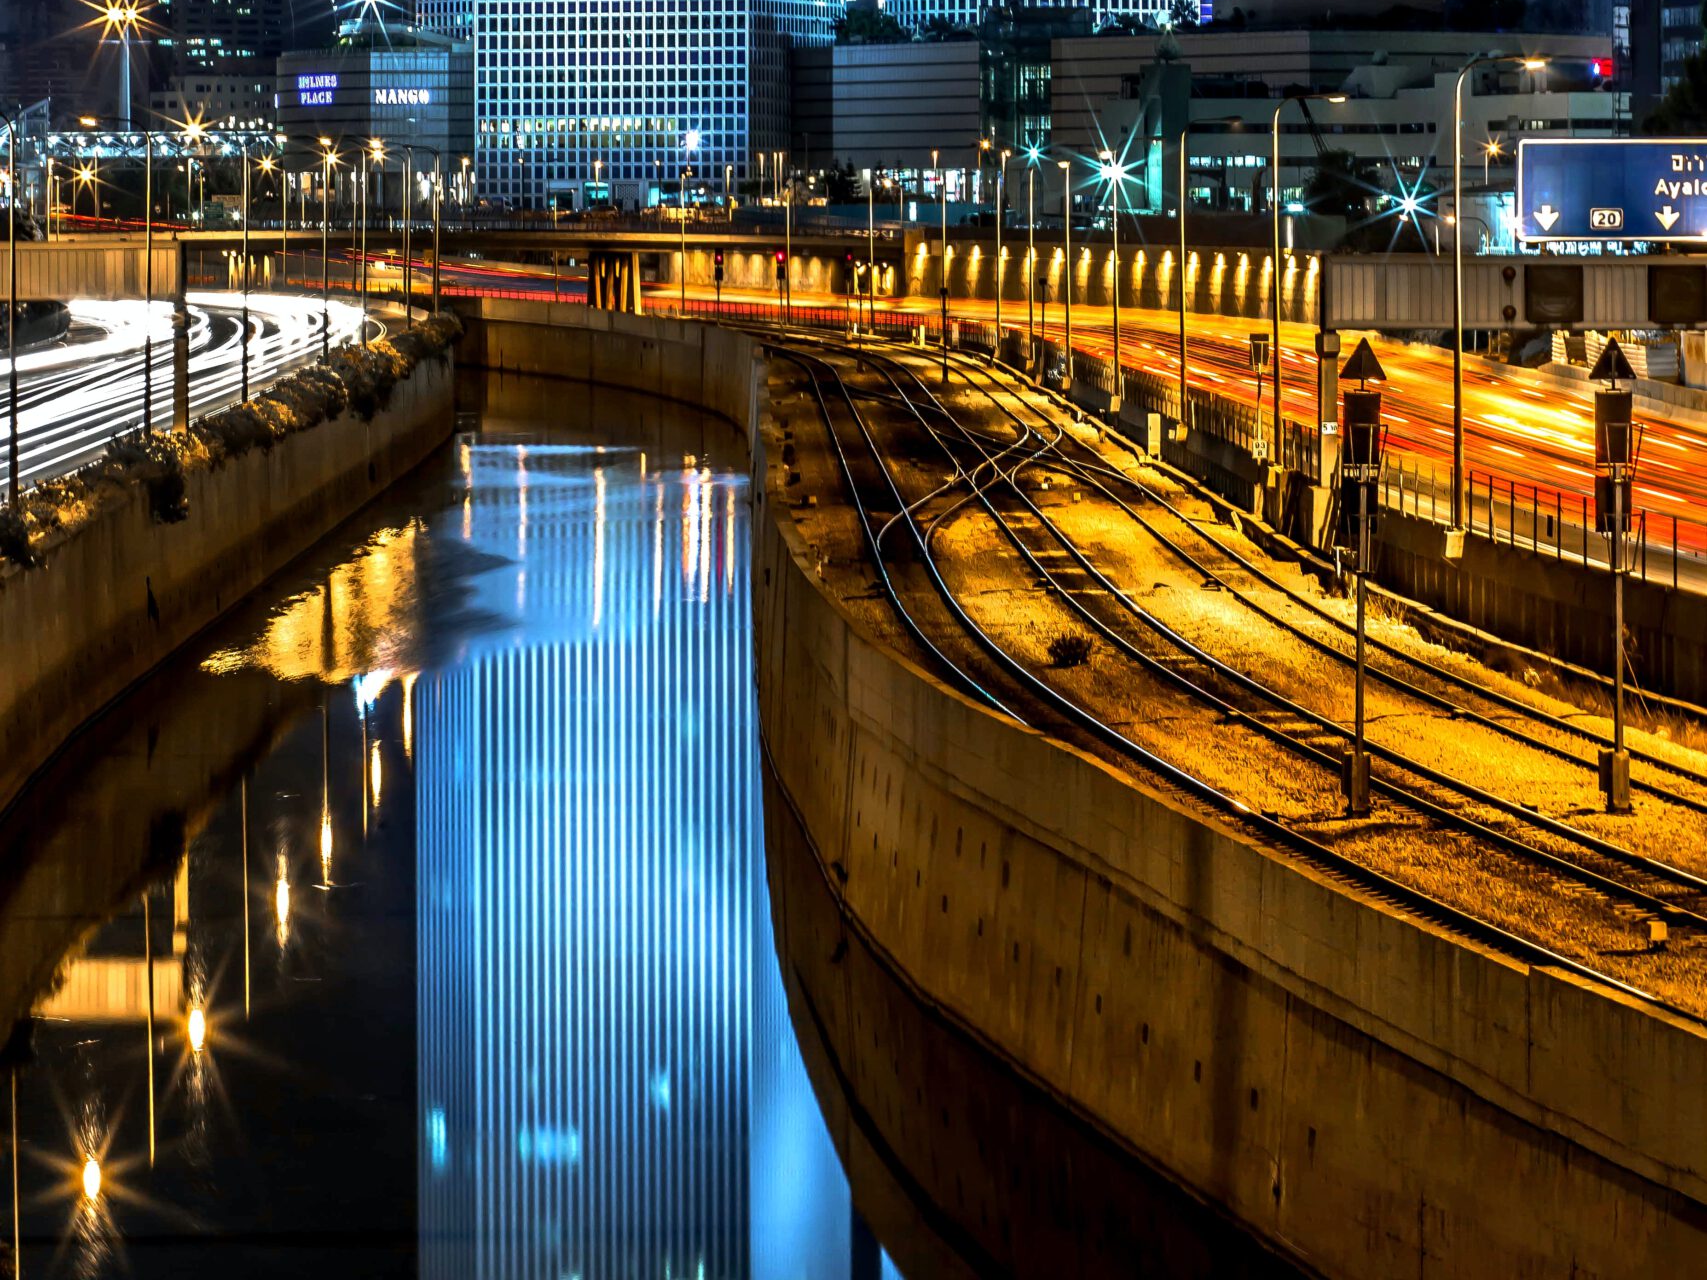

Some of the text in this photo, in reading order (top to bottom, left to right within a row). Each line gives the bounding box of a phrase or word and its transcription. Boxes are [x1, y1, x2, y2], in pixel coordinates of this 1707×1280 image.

[300, 91, 333, 104] PLACE
[375, 89, 430, 105] MANGO
[1671, 154, 1707, 172] רום
[1597, 212, 1617, 226] 20
